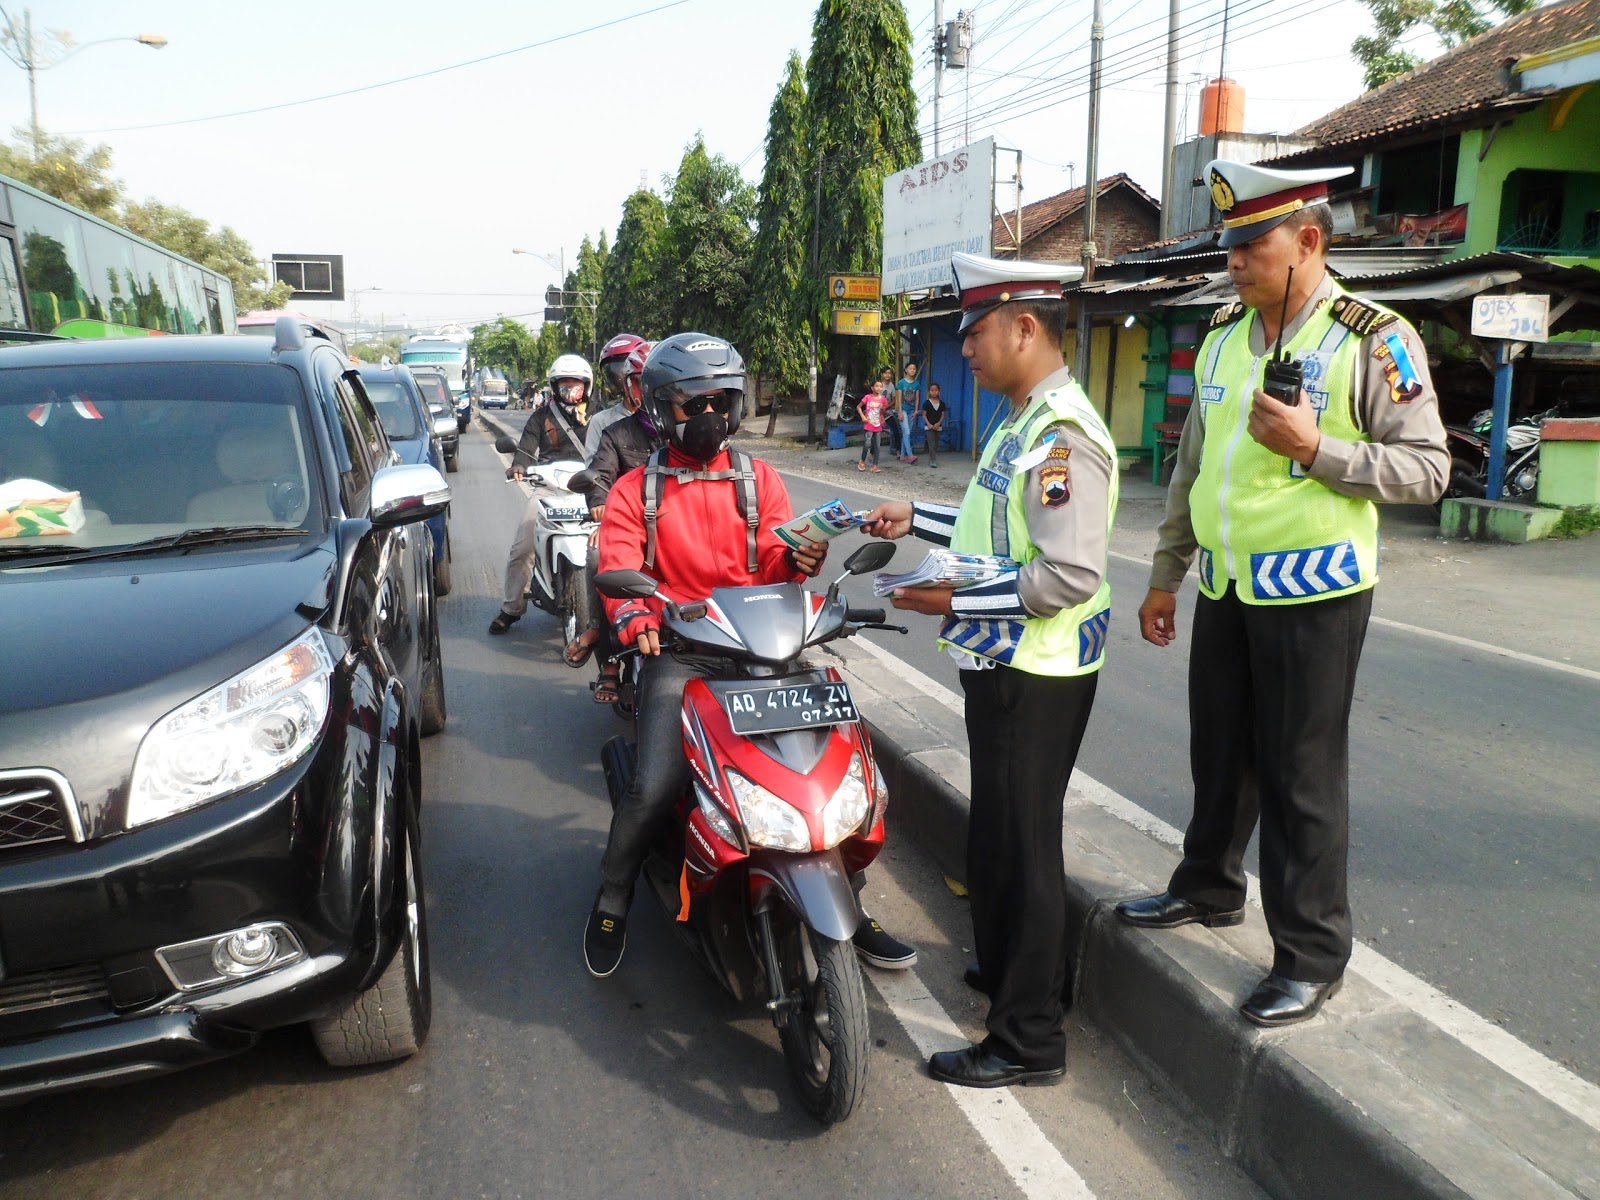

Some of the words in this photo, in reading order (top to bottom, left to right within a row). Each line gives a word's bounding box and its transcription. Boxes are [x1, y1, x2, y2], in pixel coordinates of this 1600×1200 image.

[899, 152, 969, 193] AIDS
[556, 508, 579, 516] 5927
[744, 594, 783, 602] HONDA
[733, 693, 756, 713] AD
[767, 689, 814, 709] 4724
[825, 686, 848, 703] ZV
[689, 821, 716, 860] HONDA
